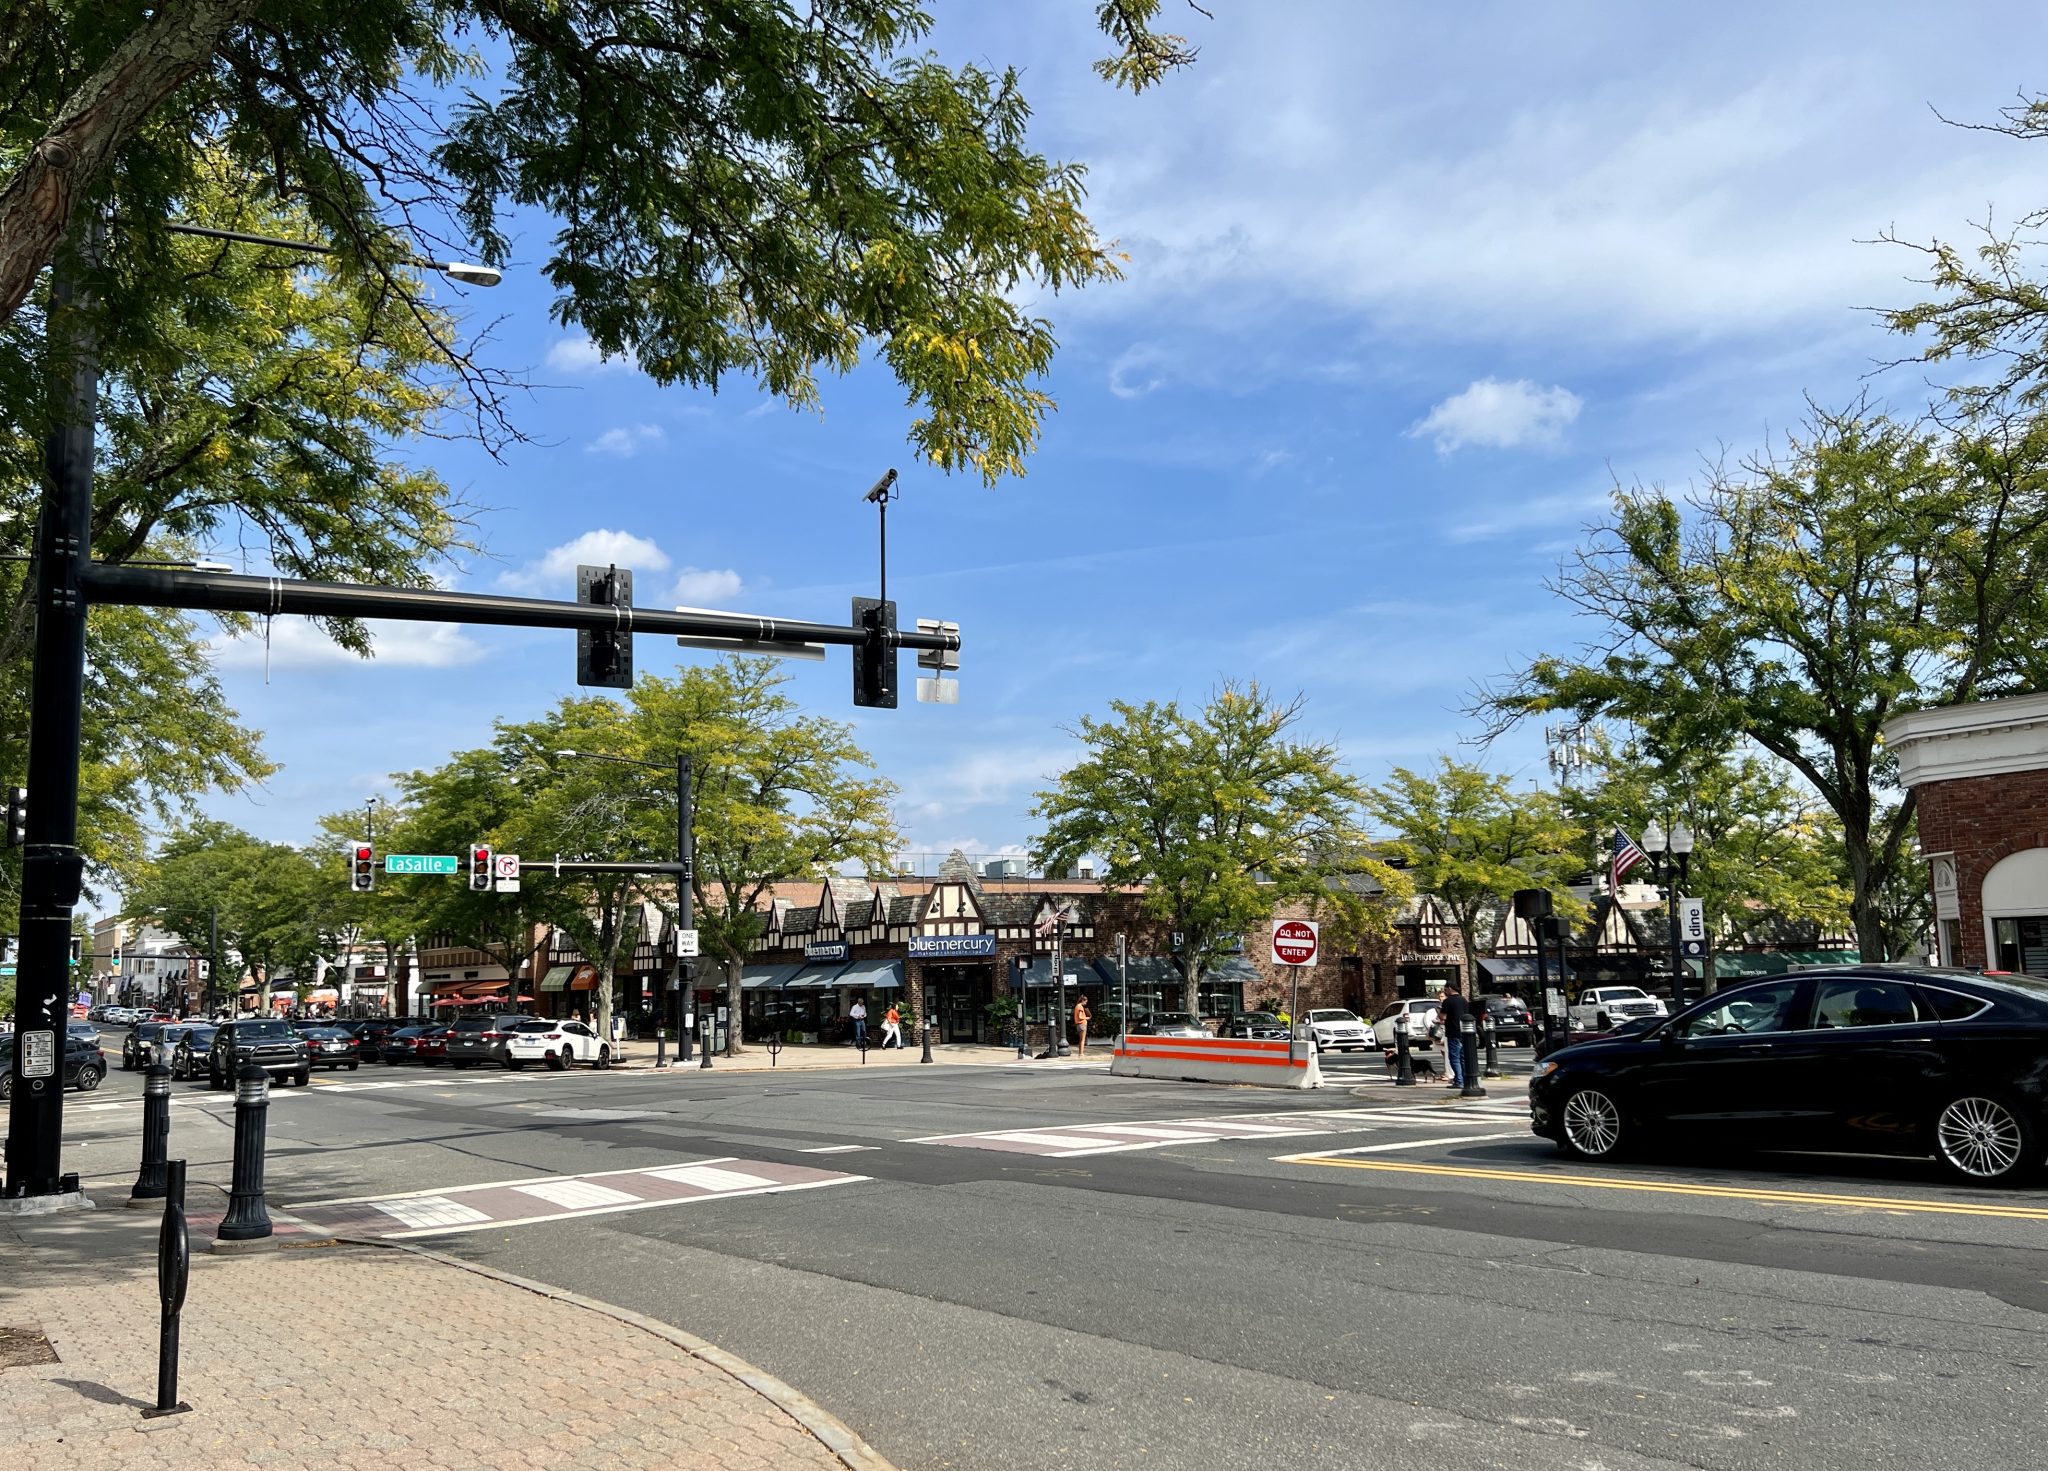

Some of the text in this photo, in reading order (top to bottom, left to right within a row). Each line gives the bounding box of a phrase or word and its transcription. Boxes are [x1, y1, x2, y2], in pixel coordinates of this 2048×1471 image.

[389, 857, 443, 872] LaSalle
[1689, 908, 1702, 937] dine
[1280, 929, 1311, 938] DO NOT
[908, 937, 993, 953] bluemercury
[1281, 948, 1307, 957] ENTER
